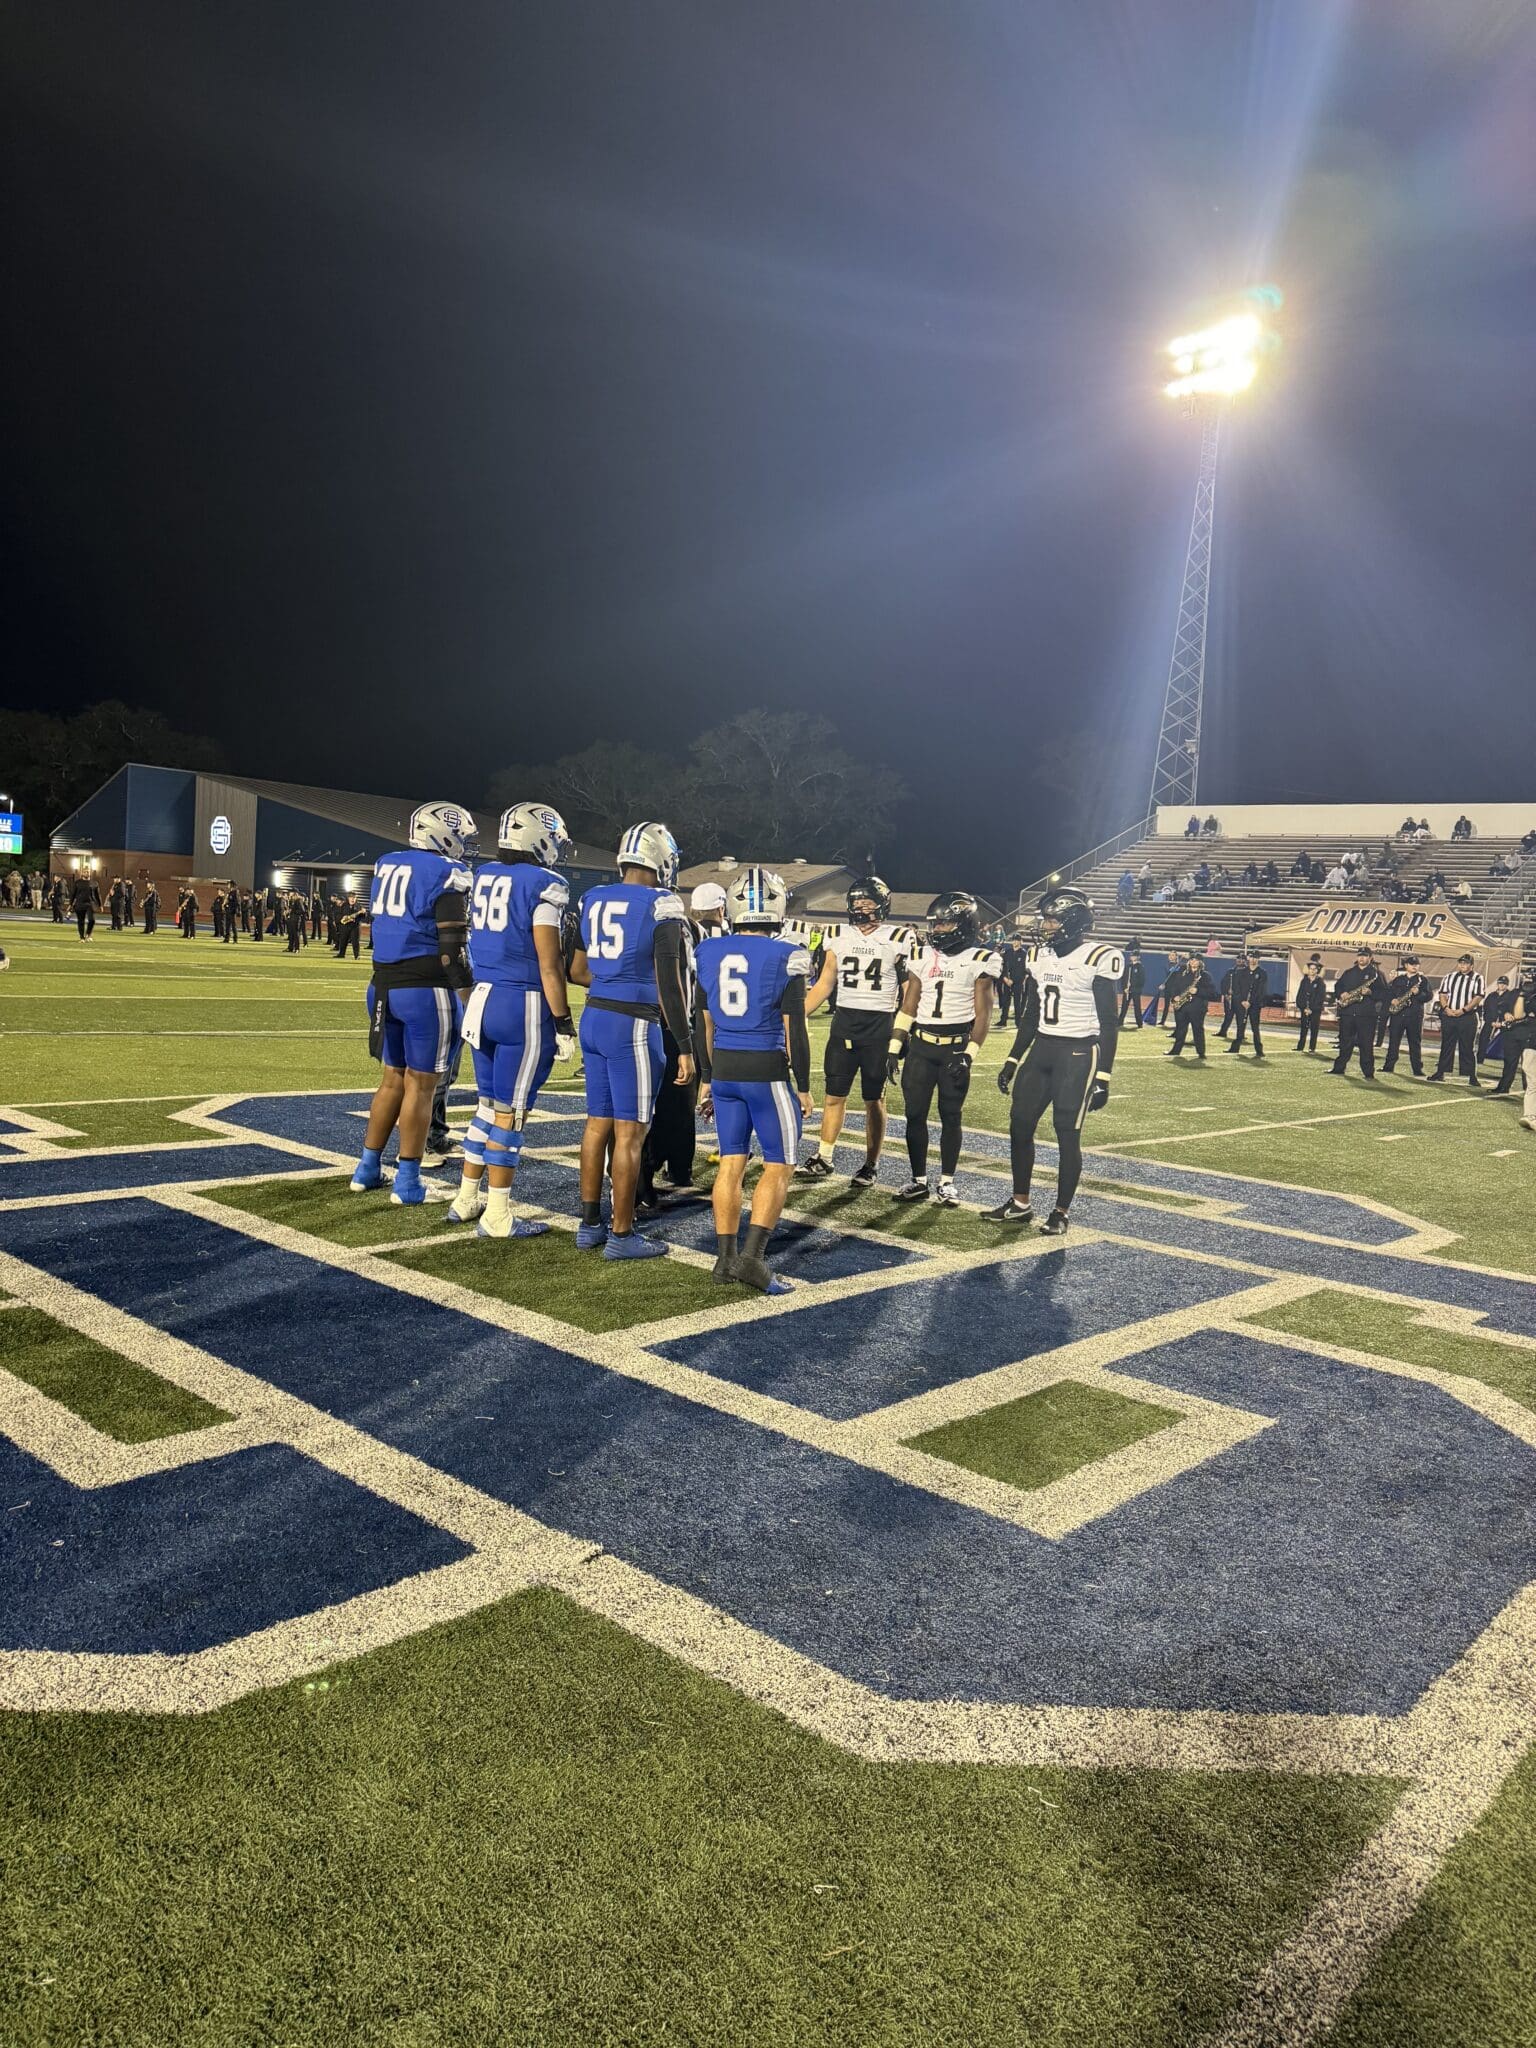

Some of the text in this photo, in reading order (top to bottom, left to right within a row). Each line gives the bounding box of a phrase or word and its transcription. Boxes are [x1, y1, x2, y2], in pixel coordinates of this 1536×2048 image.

[371, 863, 412, 918] 70
[472, 874, 513, 932] 58
[586, 900, 630, 960] 15
[1304, 907, 1448, 940] COUGARS
[851, 946, 876, 956] COUGARS
[1111, 956, 1120, 973] 0
[718, 953, 749, 1017] 6
[841, 956, 883, 991] 24
[931, 980, 945, 1019] 1
[1043, 984, 1061, 1025] 0
